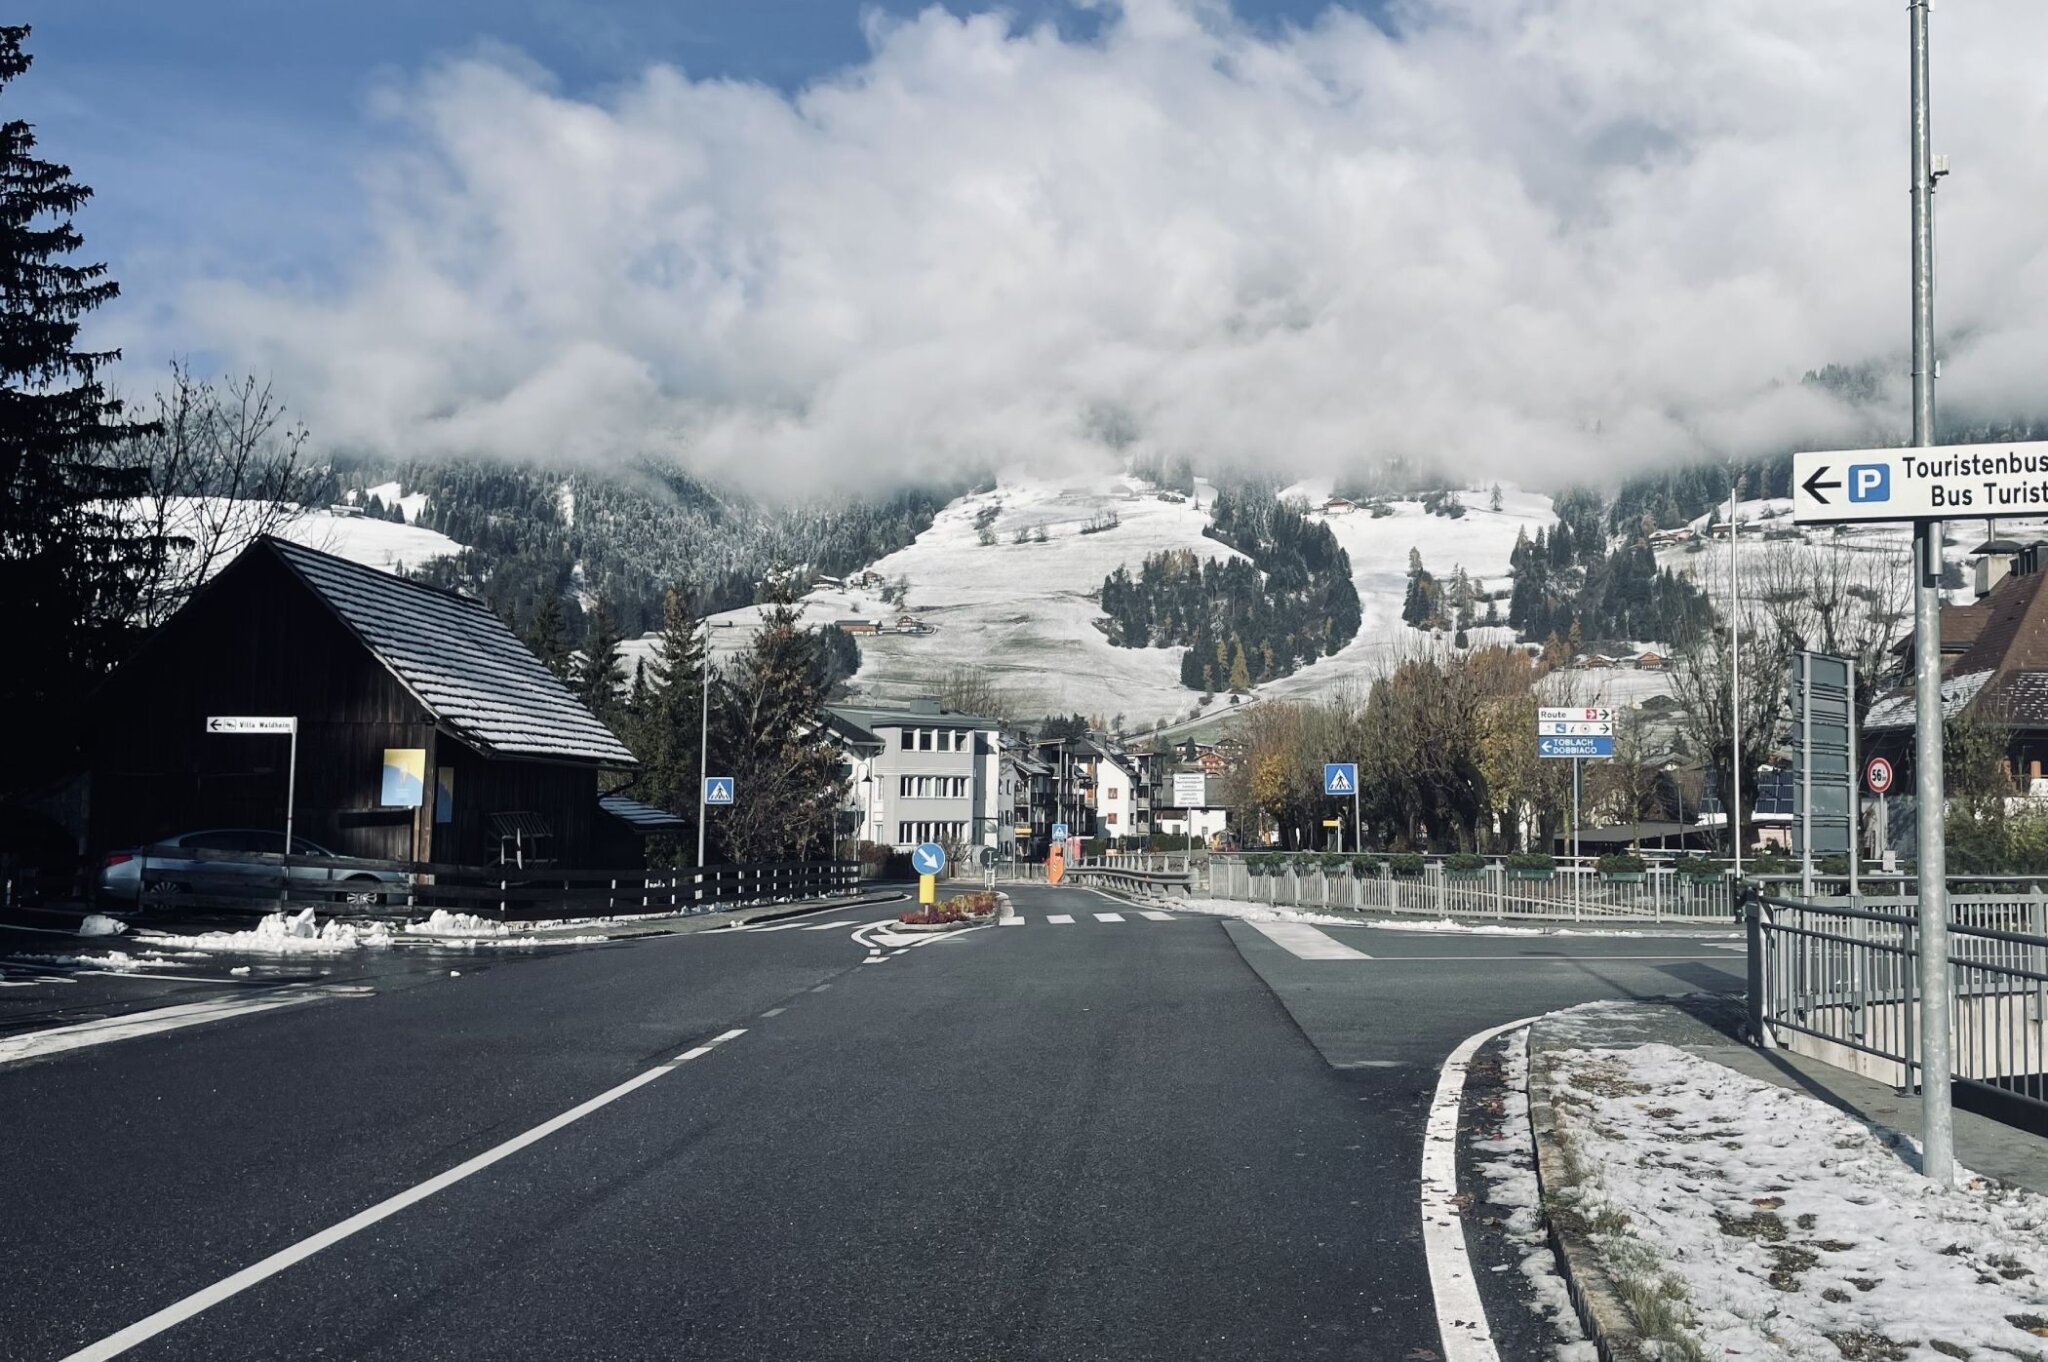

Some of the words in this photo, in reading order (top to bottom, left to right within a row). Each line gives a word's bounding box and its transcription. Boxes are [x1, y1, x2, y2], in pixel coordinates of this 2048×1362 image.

[1902, 451, 2048, 478] Touristenbus
[1857, 469, 1882, 498] P
[1931, 485, 1973, 507] Bus
[1983, 481, 2048, 505] Turist
[1540, 710, 1567, 719] Route
[1553, 738, 1594, 746] TOBLACH
[1553, 746, 1597, 754] DOBBIACO
